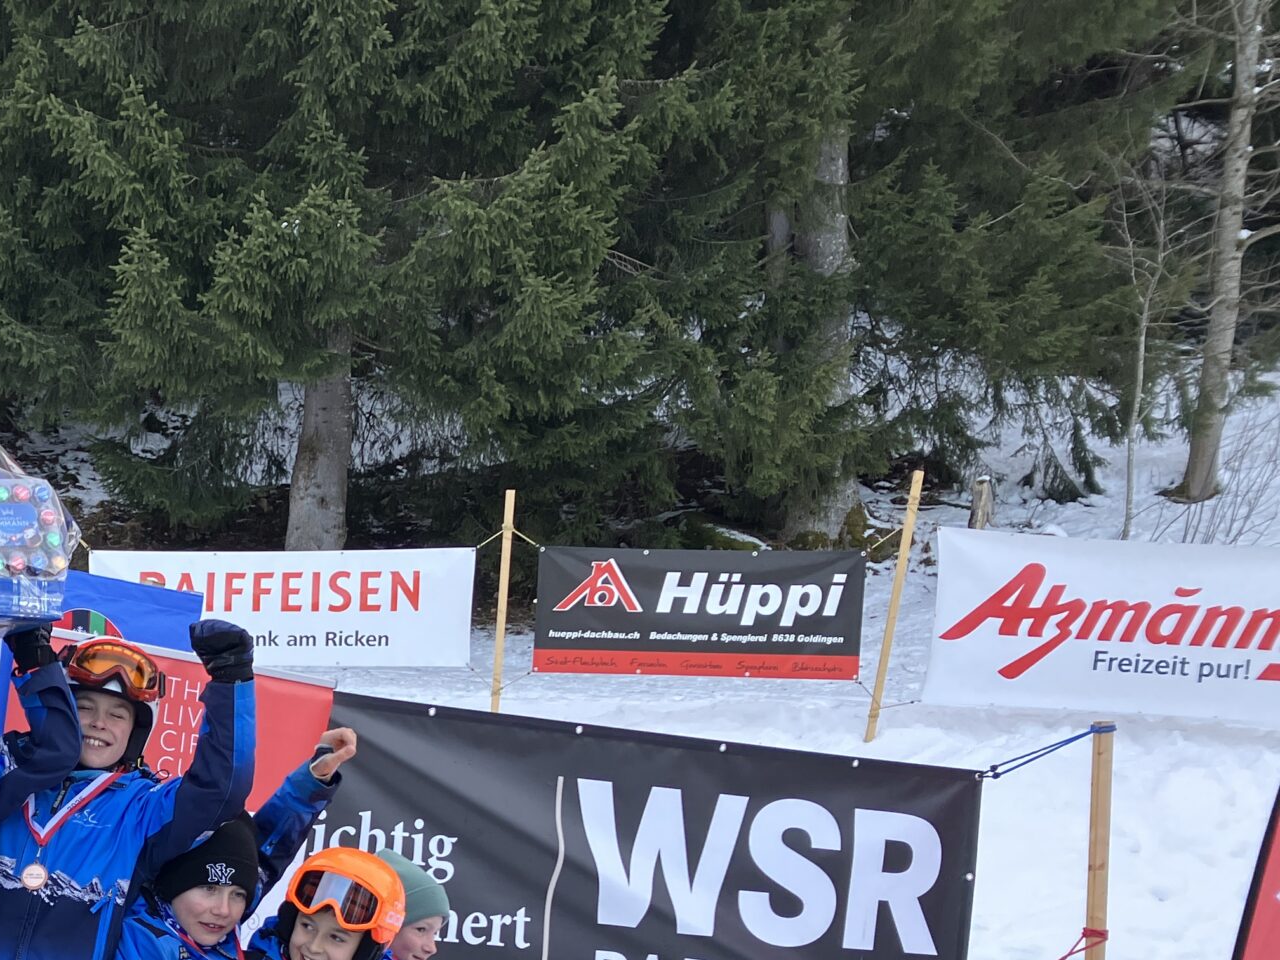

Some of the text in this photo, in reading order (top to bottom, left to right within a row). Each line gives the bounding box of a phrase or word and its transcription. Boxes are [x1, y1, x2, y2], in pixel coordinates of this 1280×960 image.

[655, 571, 848, 627] Hüppi
[287, 634, 317, 647] am
[325, 630, 390, 647] Ricken
[548, 629, 845, 645] hueppi-dachbau.ch Bedachungen & Spenglerei 8638 Goldingen
[1092, 650, 1252, 683] Freizeit pur!
[206, 862, 236, 886] NY
[577, 777, 942, 957] WSR
